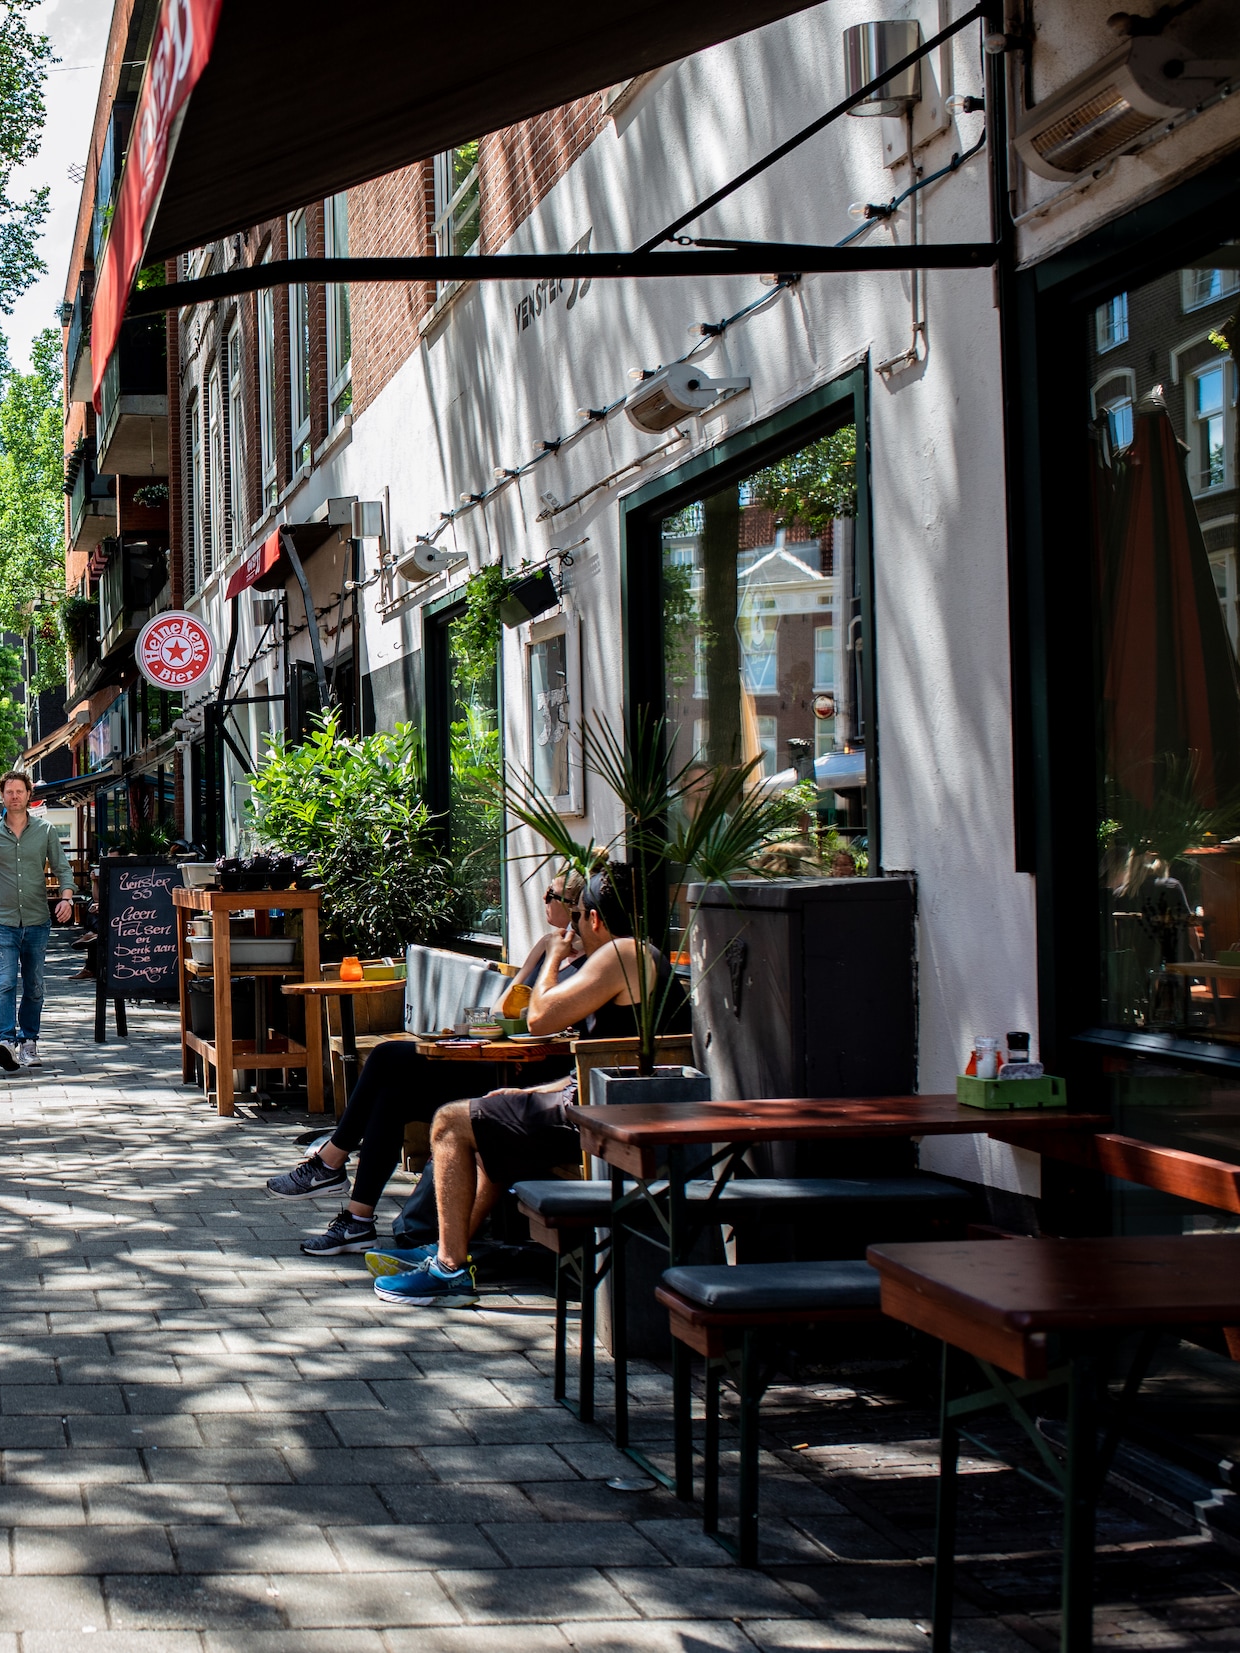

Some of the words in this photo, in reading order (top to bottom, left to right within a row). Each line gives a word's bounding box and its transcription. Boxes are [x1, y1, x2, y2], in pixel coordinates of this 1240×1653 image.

[144, 619, 207, 665] Heineken's
[158, 668, 194, 683] Bier
[132, 888, 153, 900] 33
[121, 906, 158, 921] Geen
[135, 936, 151, 944] en
[113, 943, 151, 957] Denk
[153, 944, 177, 953] aan
